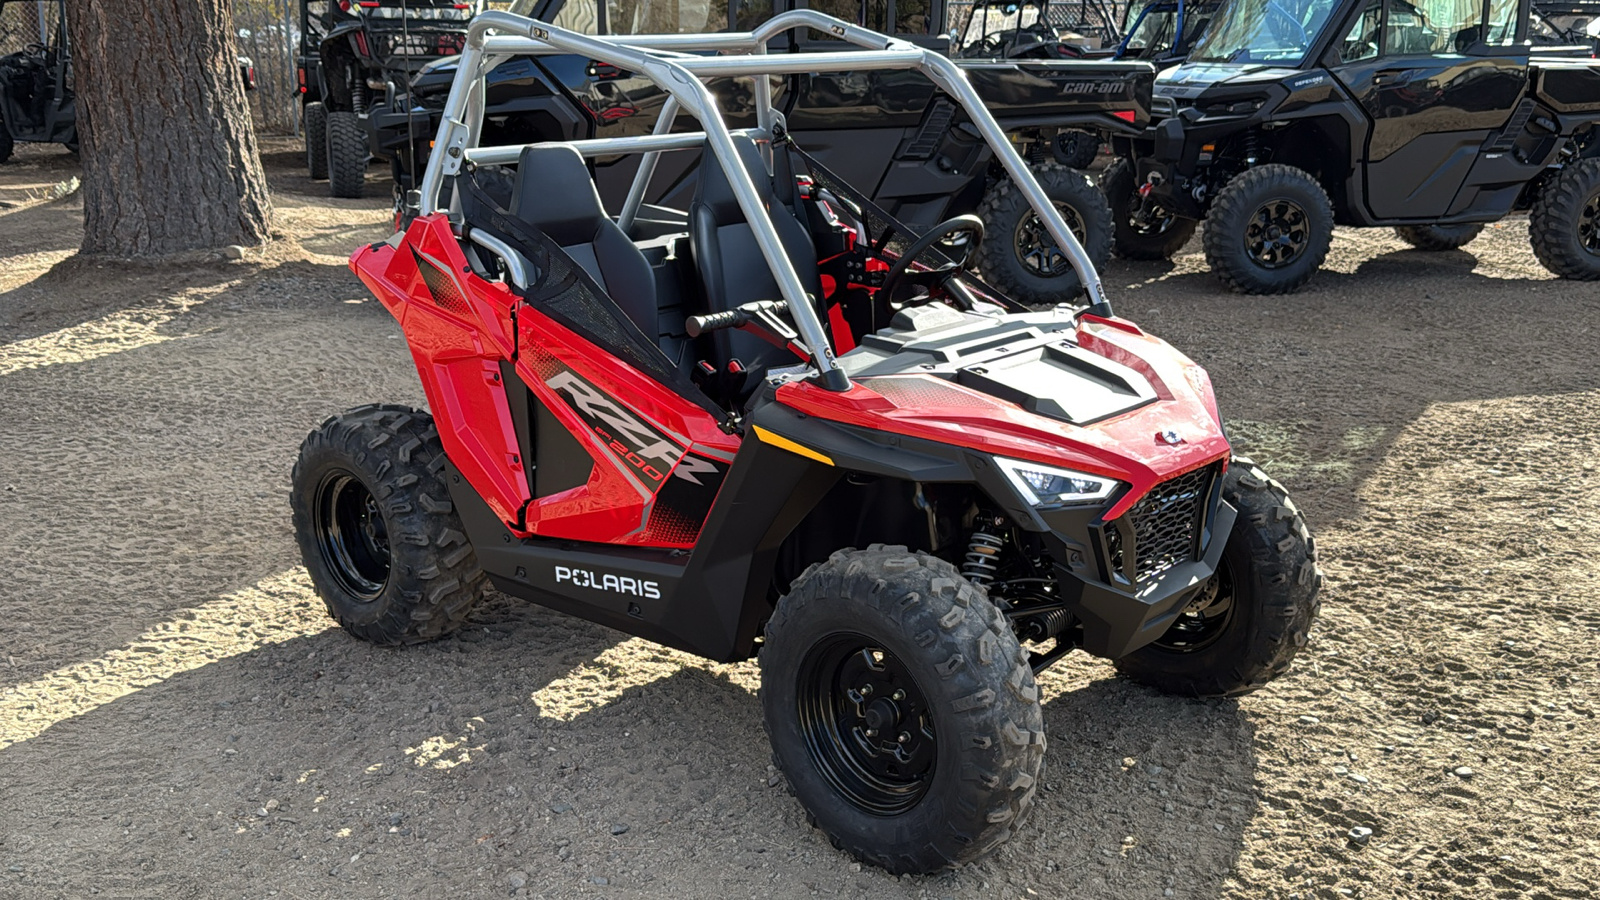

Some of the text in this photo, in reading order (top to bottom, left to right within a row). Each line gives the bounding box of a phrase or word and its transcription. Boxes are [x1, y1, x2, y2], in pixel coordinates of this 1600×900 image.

[1062, 82, 1125, 94] can-am
[545, 370, 719, 486] RZR
[609, 438, 664, 481] 200
[554, 565, 661, 600] POLARIS
